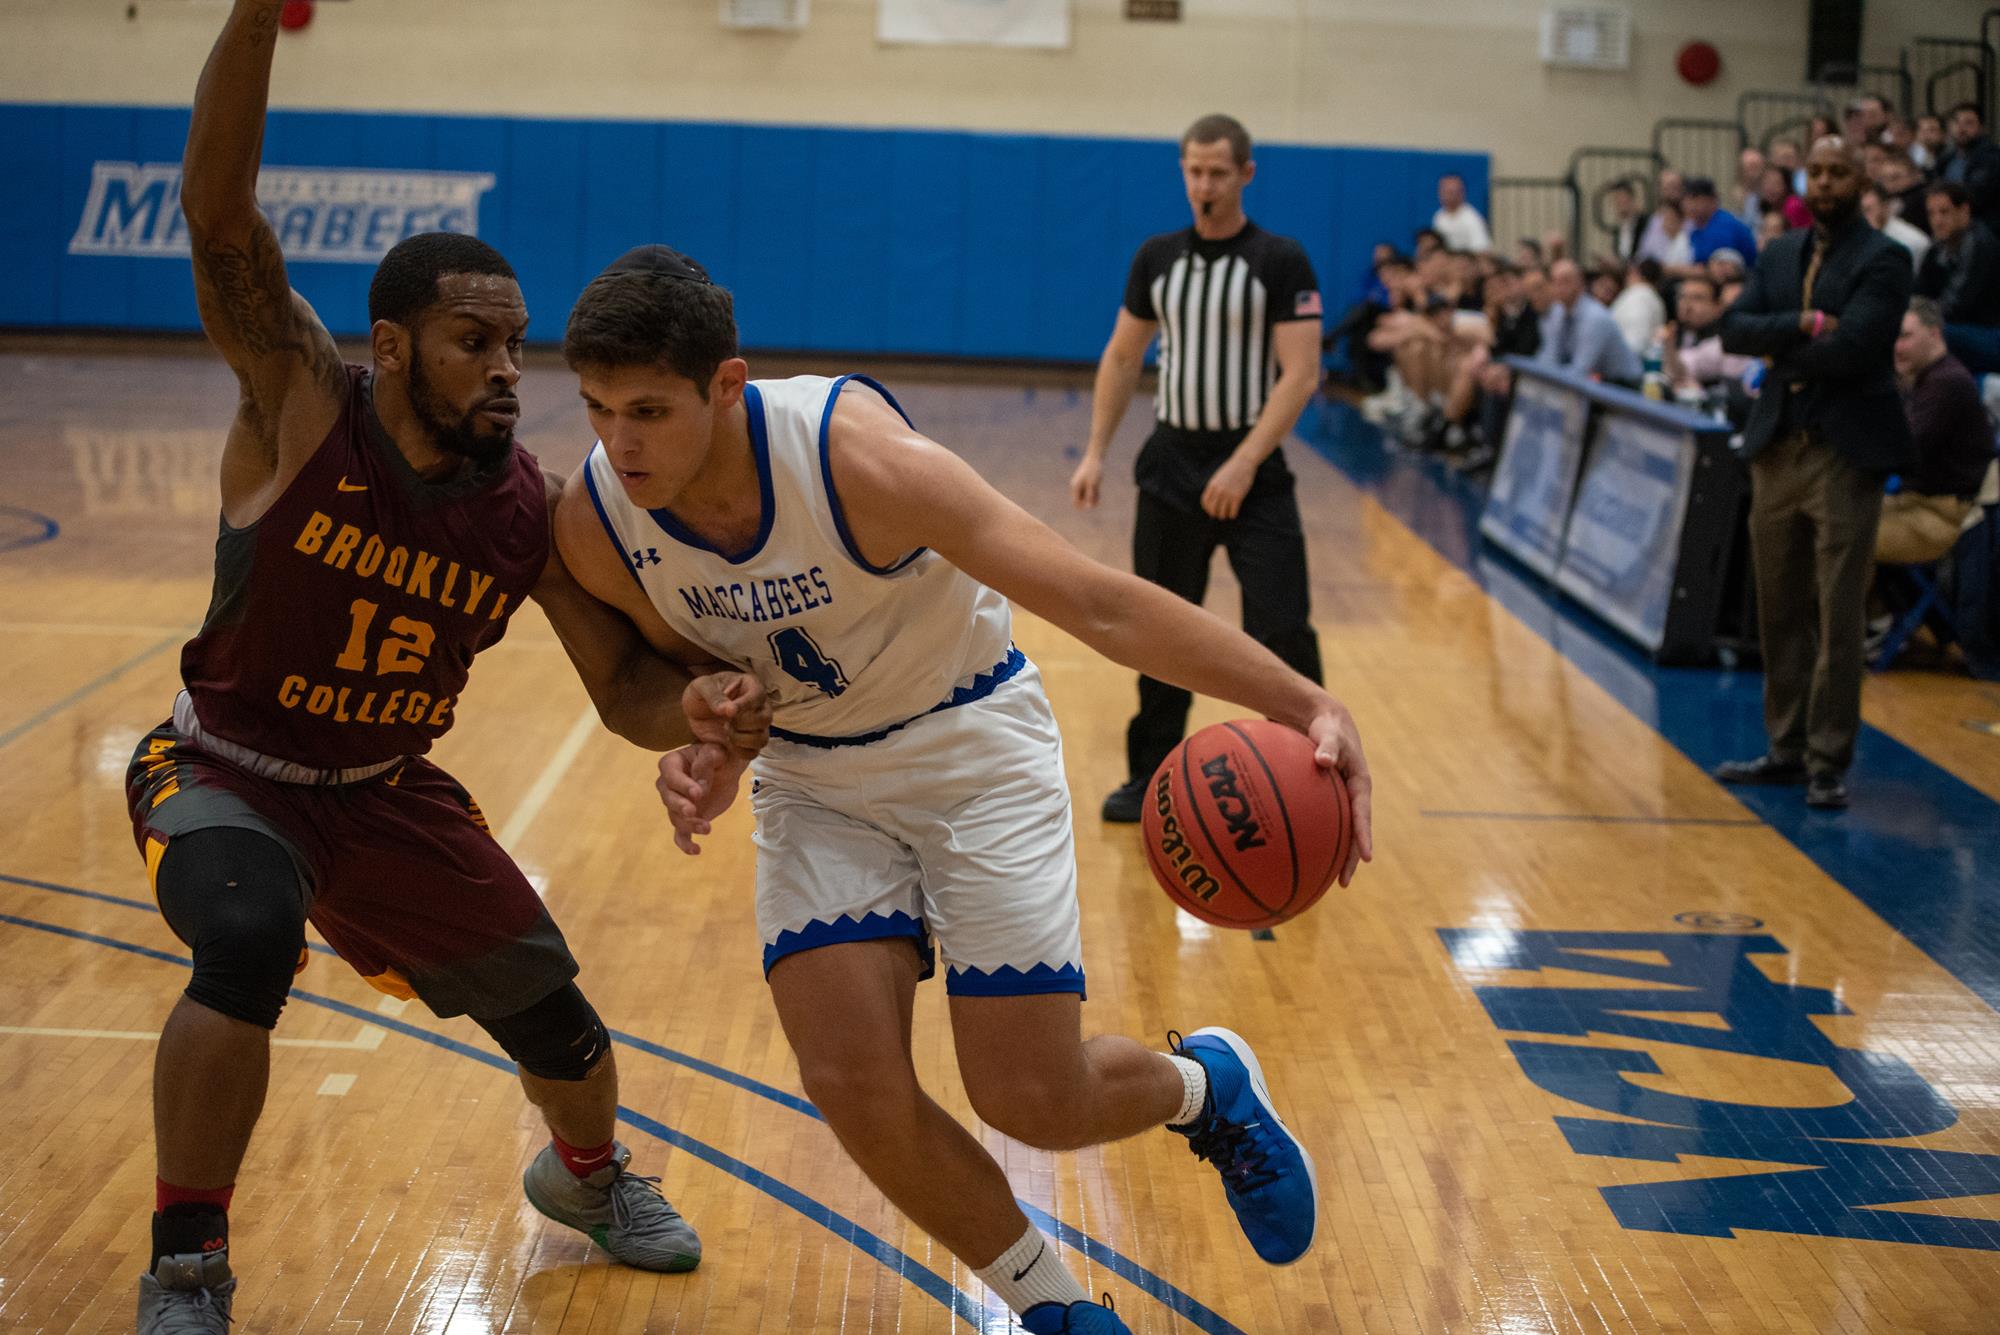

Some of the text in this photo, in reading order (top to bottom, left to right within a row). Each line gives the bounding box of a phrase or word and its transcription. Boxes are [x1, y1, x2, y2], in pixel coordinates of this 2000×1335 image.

[678, 566, 833, 622] MACCABEES
[335, 598, 436, 676] 12
[767, 626, 850, 699] 4
[277, 675, 450, 725] COLLEGE
[1156, 768, 1221, 903] Wilson
[1201, 753, 1266, 853] NCAA
[1435, 927, 2000, 1253] NCAA
